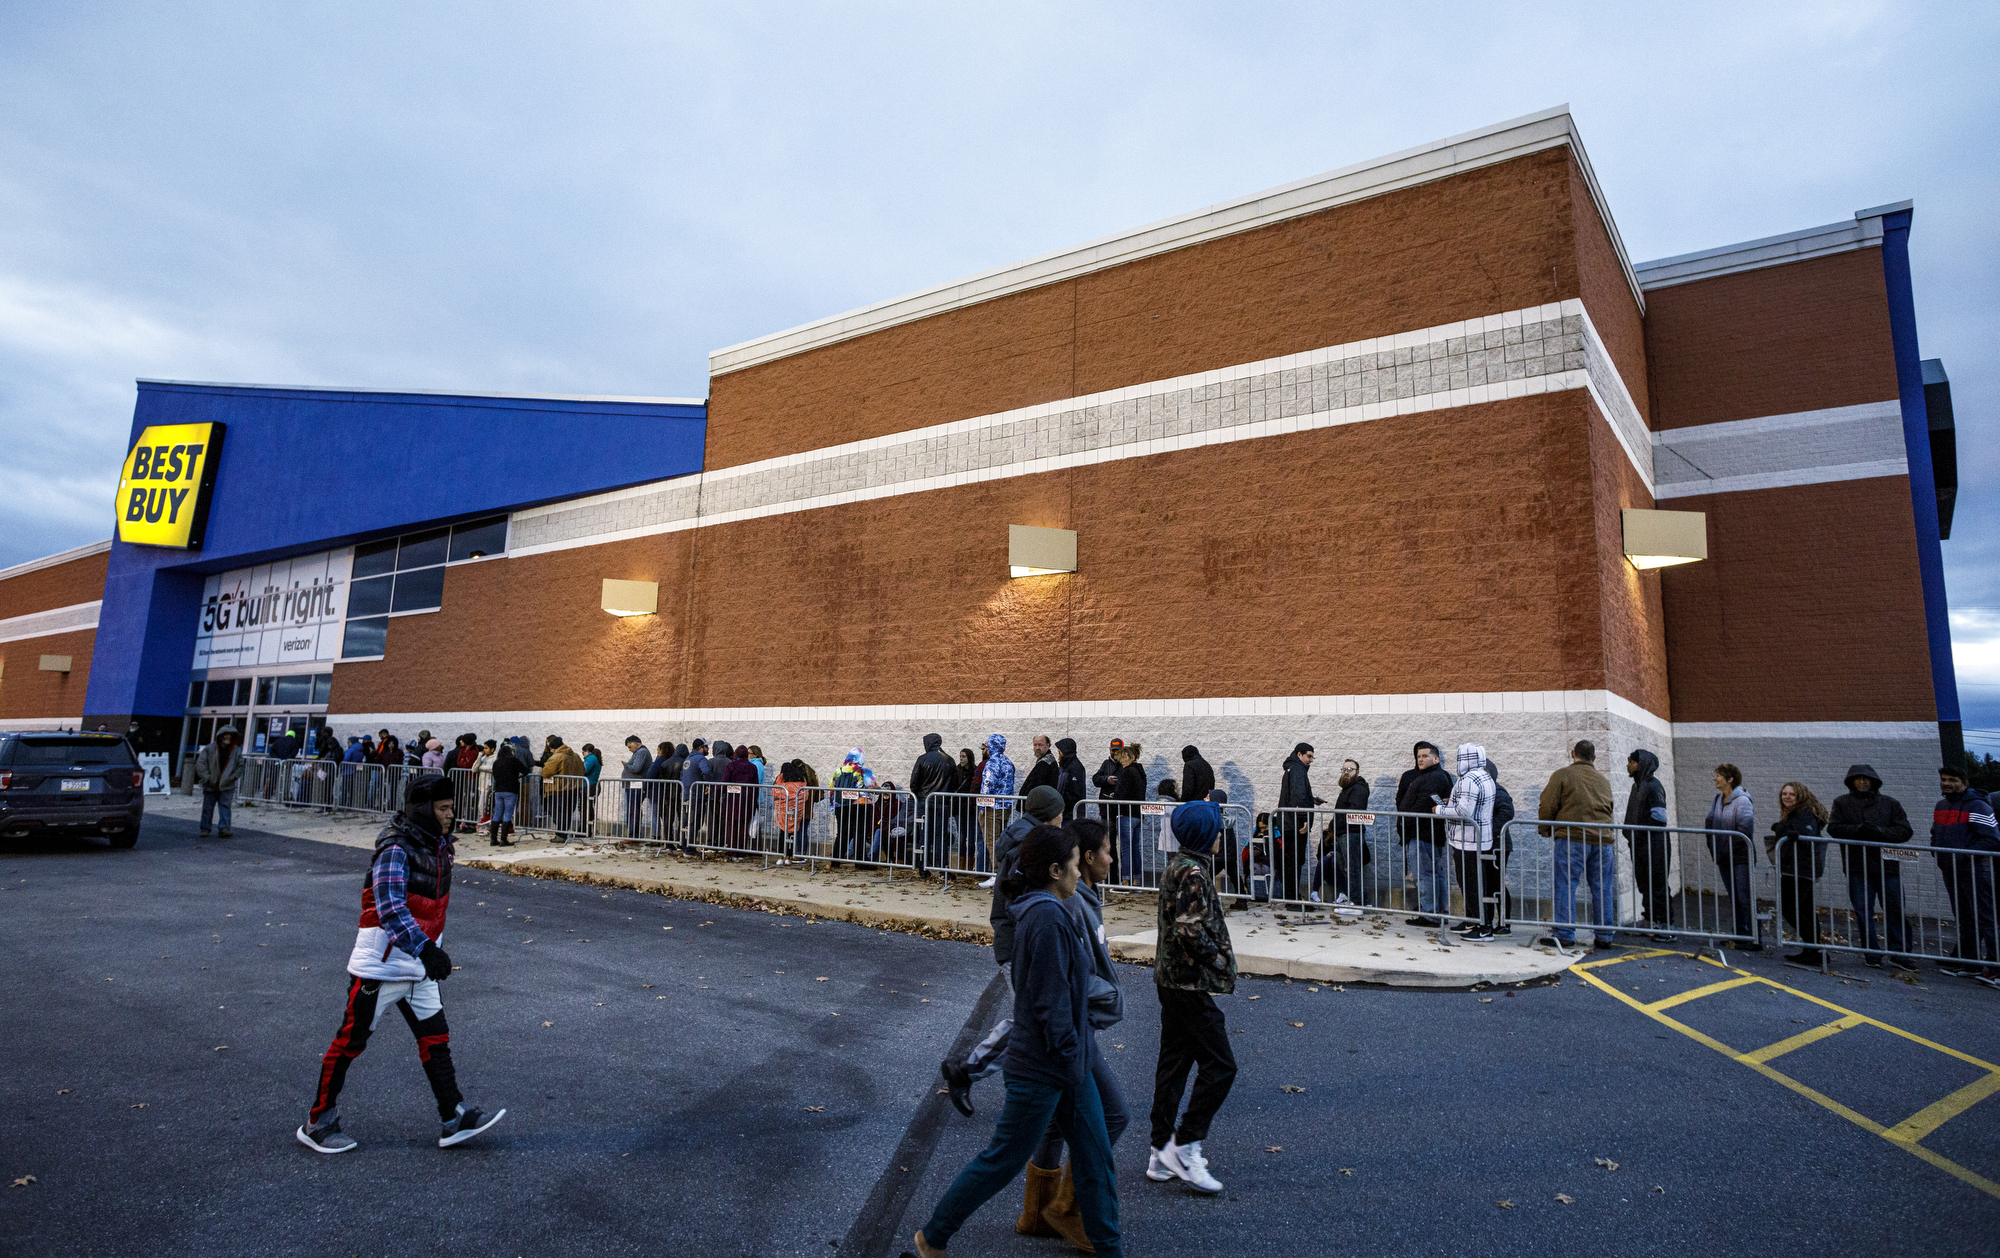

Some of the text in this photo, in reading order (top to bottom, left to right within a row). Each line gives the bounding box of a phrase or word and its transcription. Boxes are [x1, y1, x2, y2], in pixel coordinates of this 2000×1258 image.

[131, 444, 204, 482] BEST
[125, 488, 190, 524] BUY
[203, 577, 335, 632] 5G built right.
[283, 637, 310, 652] verizon
[1883, 849, 1919, 857] NATIONAL
